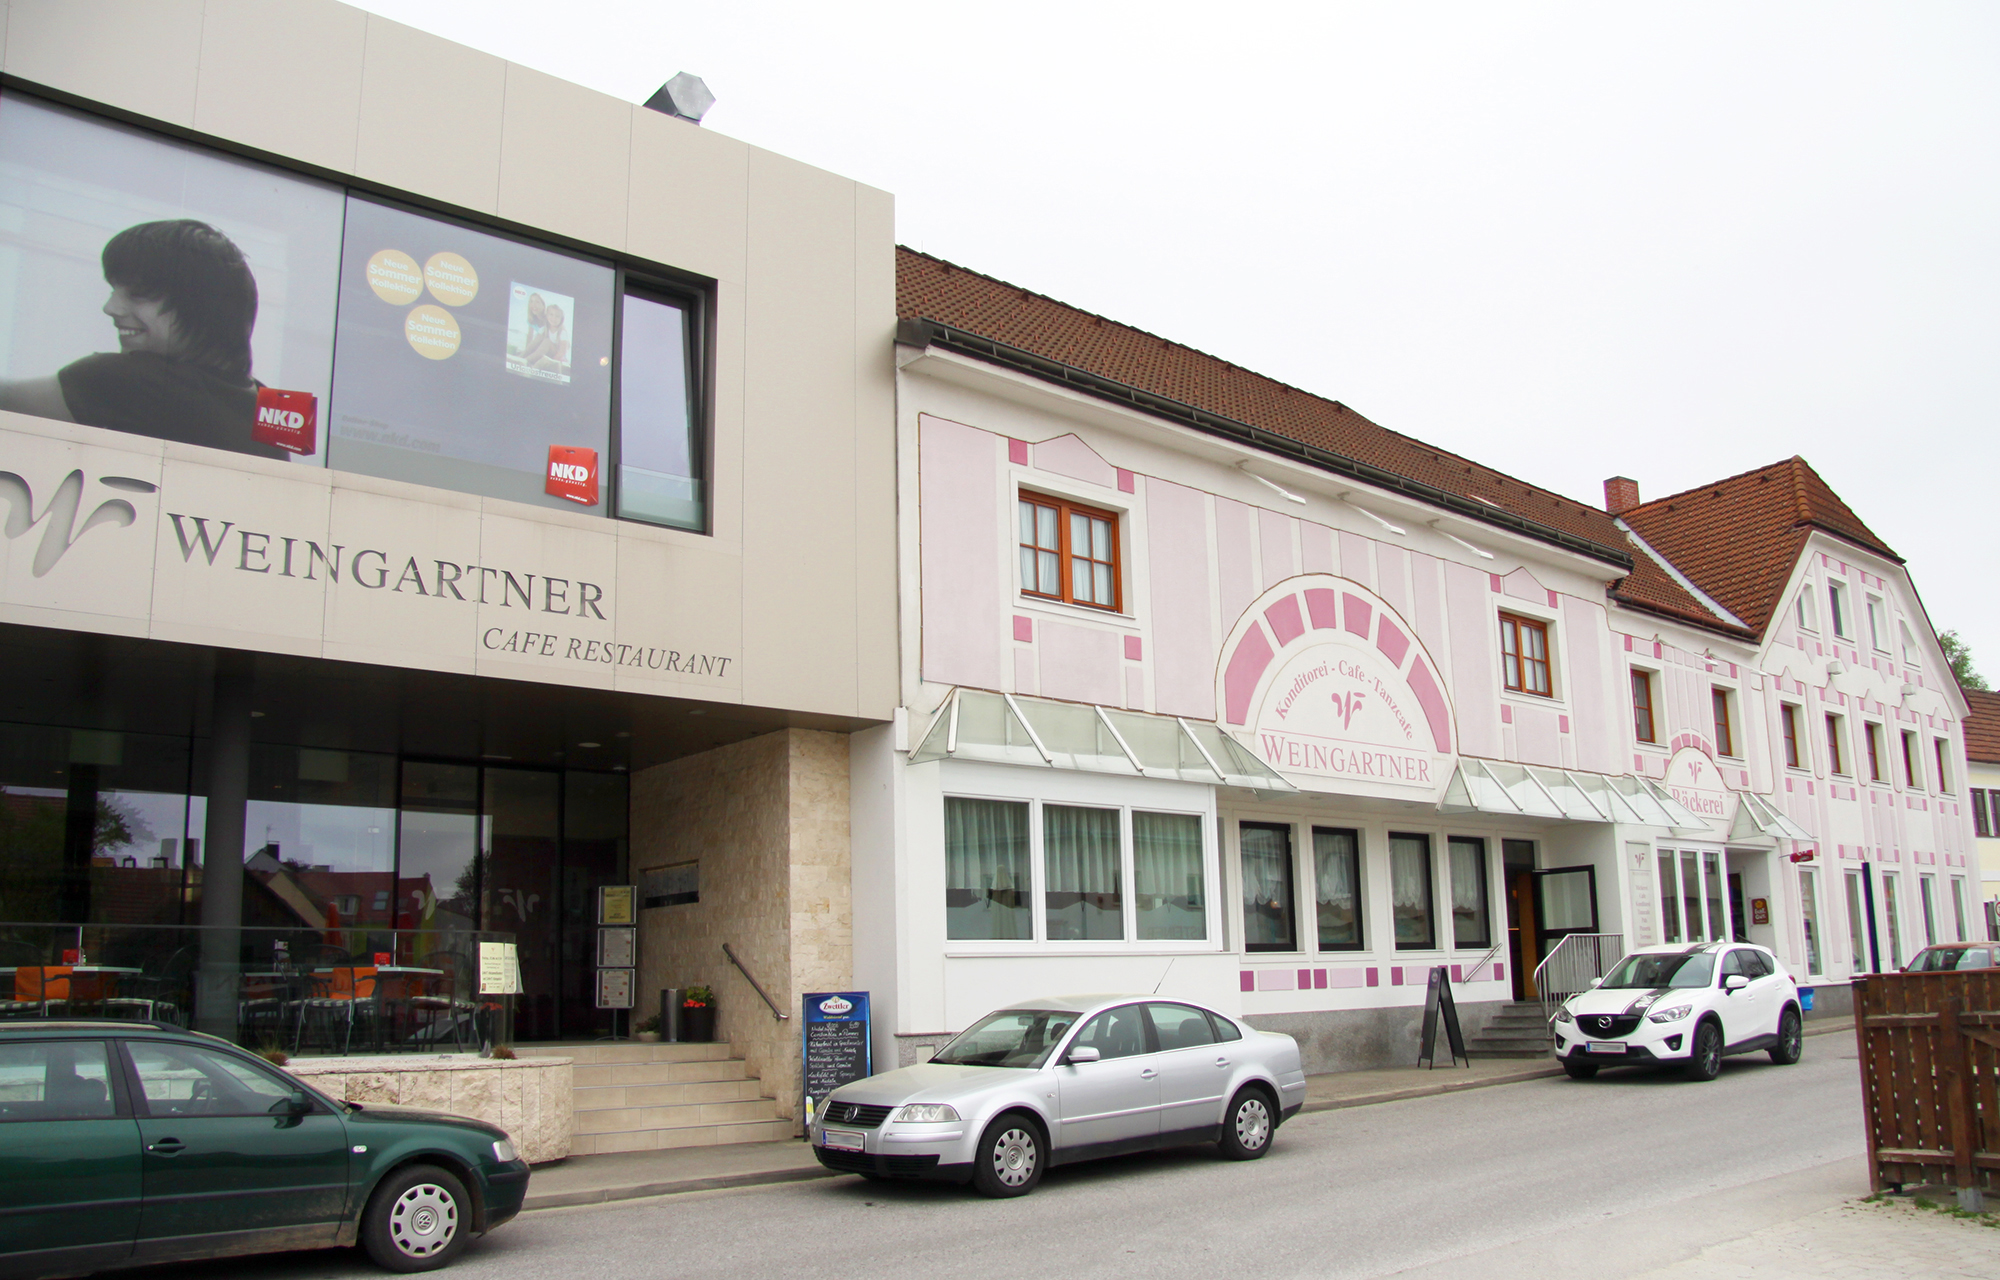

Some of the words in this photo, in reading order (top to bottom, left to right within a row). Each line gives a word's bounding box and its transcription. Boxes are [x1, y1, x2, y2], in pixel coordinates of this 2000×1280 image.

[370, 264, 421, 285] Sommer
[384, 258, 408, 271] Neue
[440, 260, 464, 273] Neue
[371, 277, 418, 295] Kollektion
[426, 266, 476, 287] Sommer
[428, 279, 473, 297] Kollektion
[421, 313, 446, 325] Neue
[408, 320, 459, 339] Sommer
[410, 334, 456, 349] Kollektion
[259, 406, 305, 429] NKD
[551, 462, 589, 482] NKD
[167, 512, 607, 621] WEINGARTNER
[482, 627, 558, 657] CAFE
[565, 637, 732, 678] RESTAURANT
[1275, 660, 1329, 721] Konditorei
[1338, 660, 1366, 682] Cafe
[1373, 676, 1414, 741] Tanzcafe
[1260, 733, 1431, 783] WEINGARTNER
[1671, 788, 1725, 815] Bäckerei
[823, 1002, 850, 1010] Zwettler
